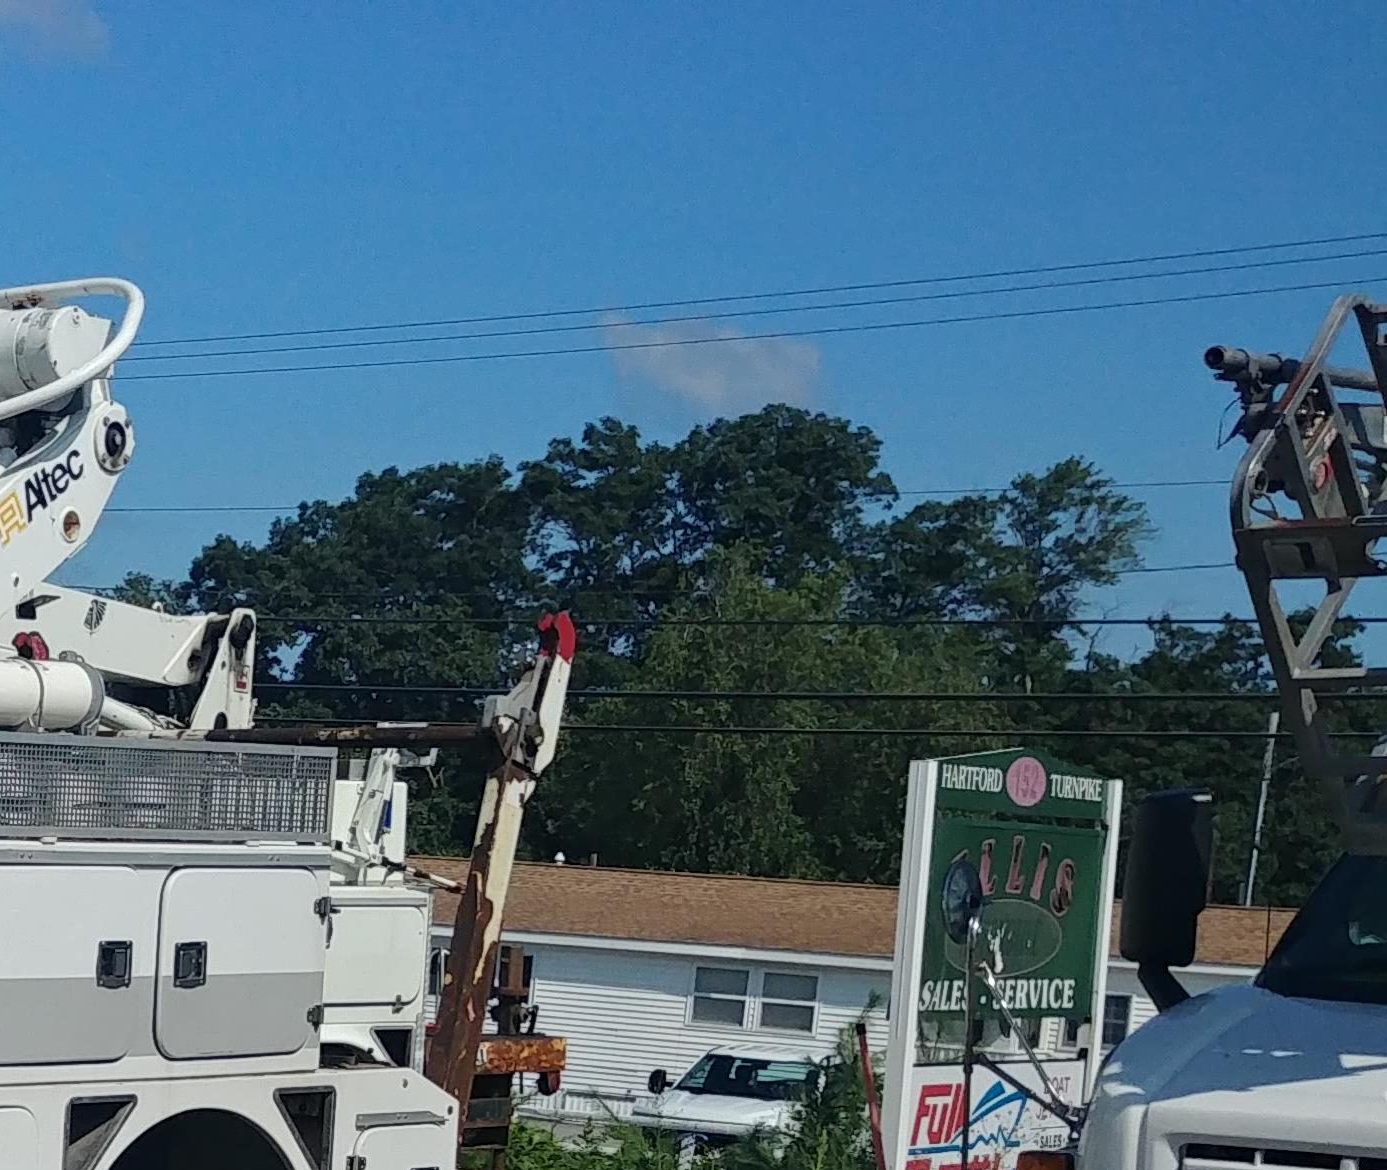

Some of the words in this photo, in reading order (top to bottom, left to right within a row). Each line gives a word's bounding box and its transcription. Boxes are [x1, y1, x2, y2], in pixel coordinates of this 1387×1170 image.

[25, 450, 84, 523] Altec
[941, 764, 1003, 793] HARTFORD
[1049, 774, 1102, 801] TURNPIKE
[951, 834, 1075, 917] LLIS
[992, 978, 1076, 1011] SERVICE
[1039, 1134, 1063, 1149] SALES
